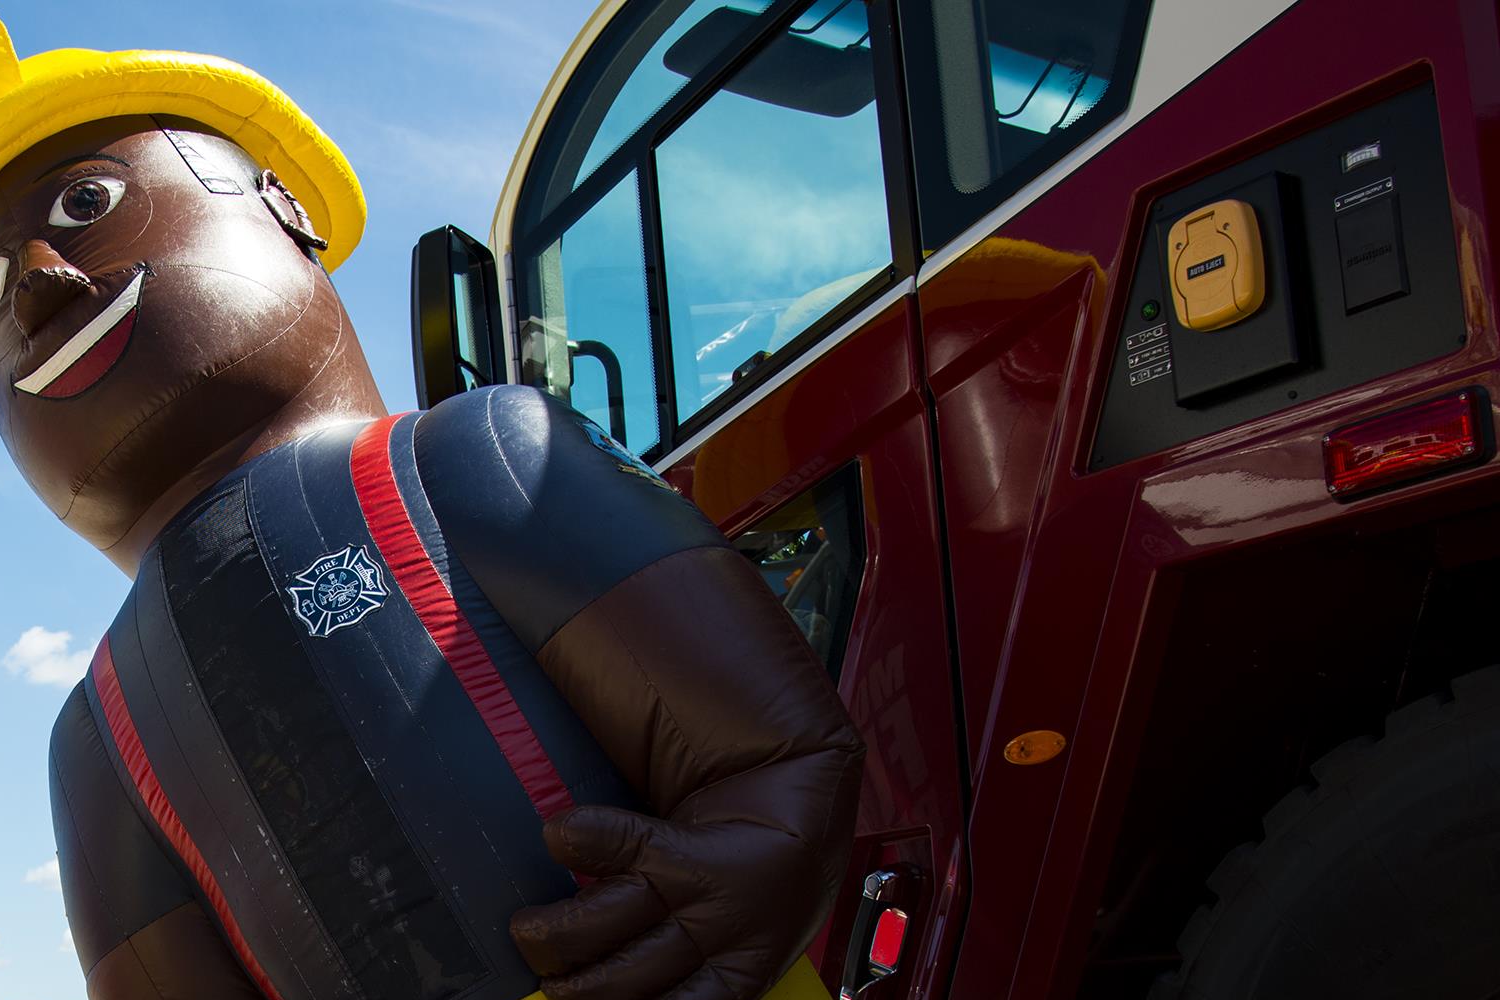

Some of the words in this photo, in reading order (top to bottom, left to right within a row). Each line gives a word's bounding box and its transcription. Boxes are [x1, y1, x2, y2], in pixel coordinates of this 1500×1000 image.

[1189, 264, 1205, 277] AUTO
[1205, 257, 1223, 271] EJECT
[314, 558, 339, 575] FIRE
[337, 604, 364, 623] DEPT.
